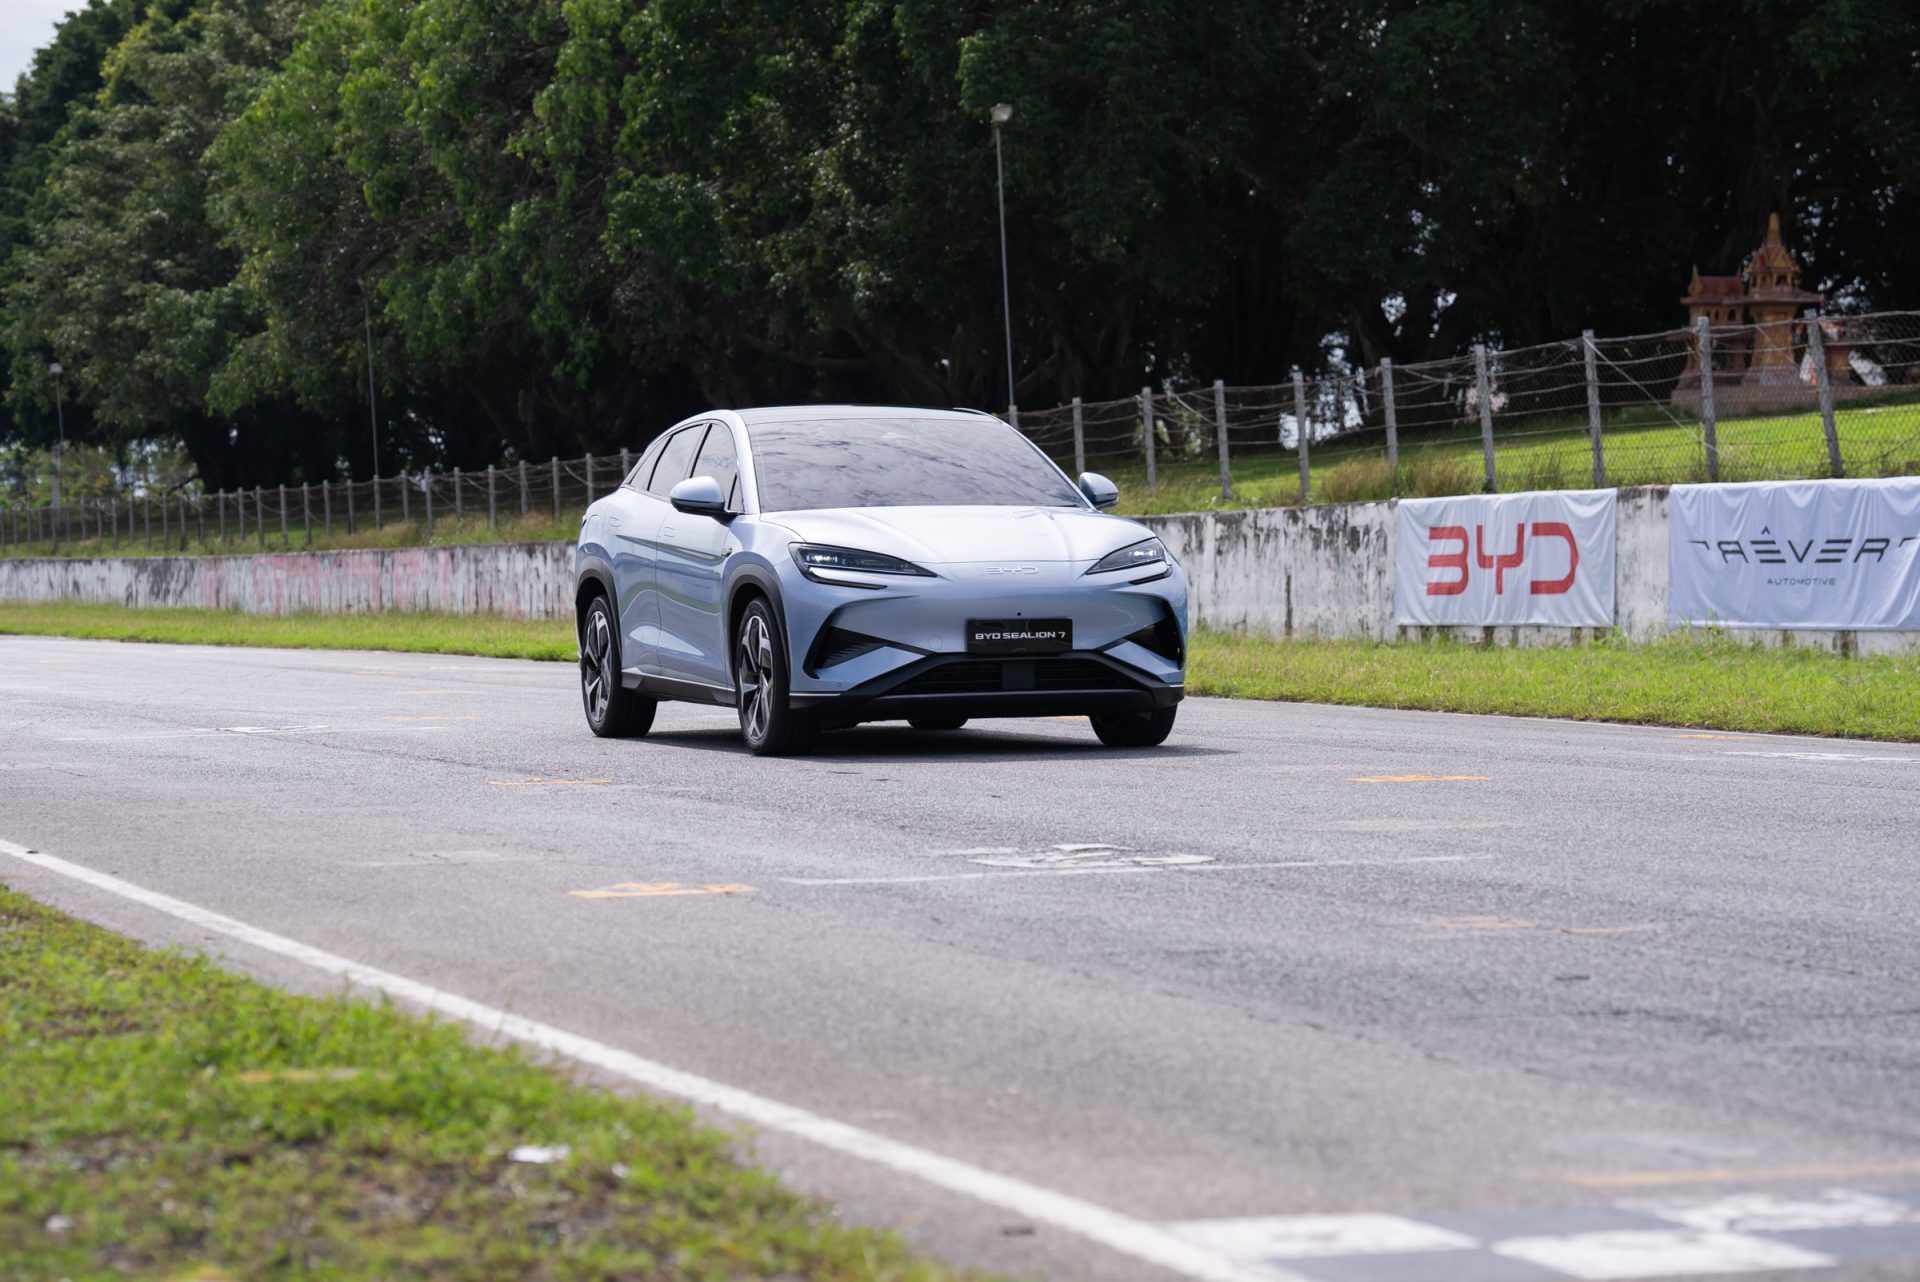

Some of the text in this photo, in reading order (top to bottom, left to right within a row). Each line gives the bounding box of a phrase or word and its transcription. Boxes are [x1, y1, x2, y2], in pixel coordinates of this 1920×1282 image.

[1427, 522, 1579, 595] BYD
[986, 566, 1039, 575] BYD
[1766, 577, 1836, 586] AUTOMOTIVE
[1002, 631, 1056, 639] SEALION
